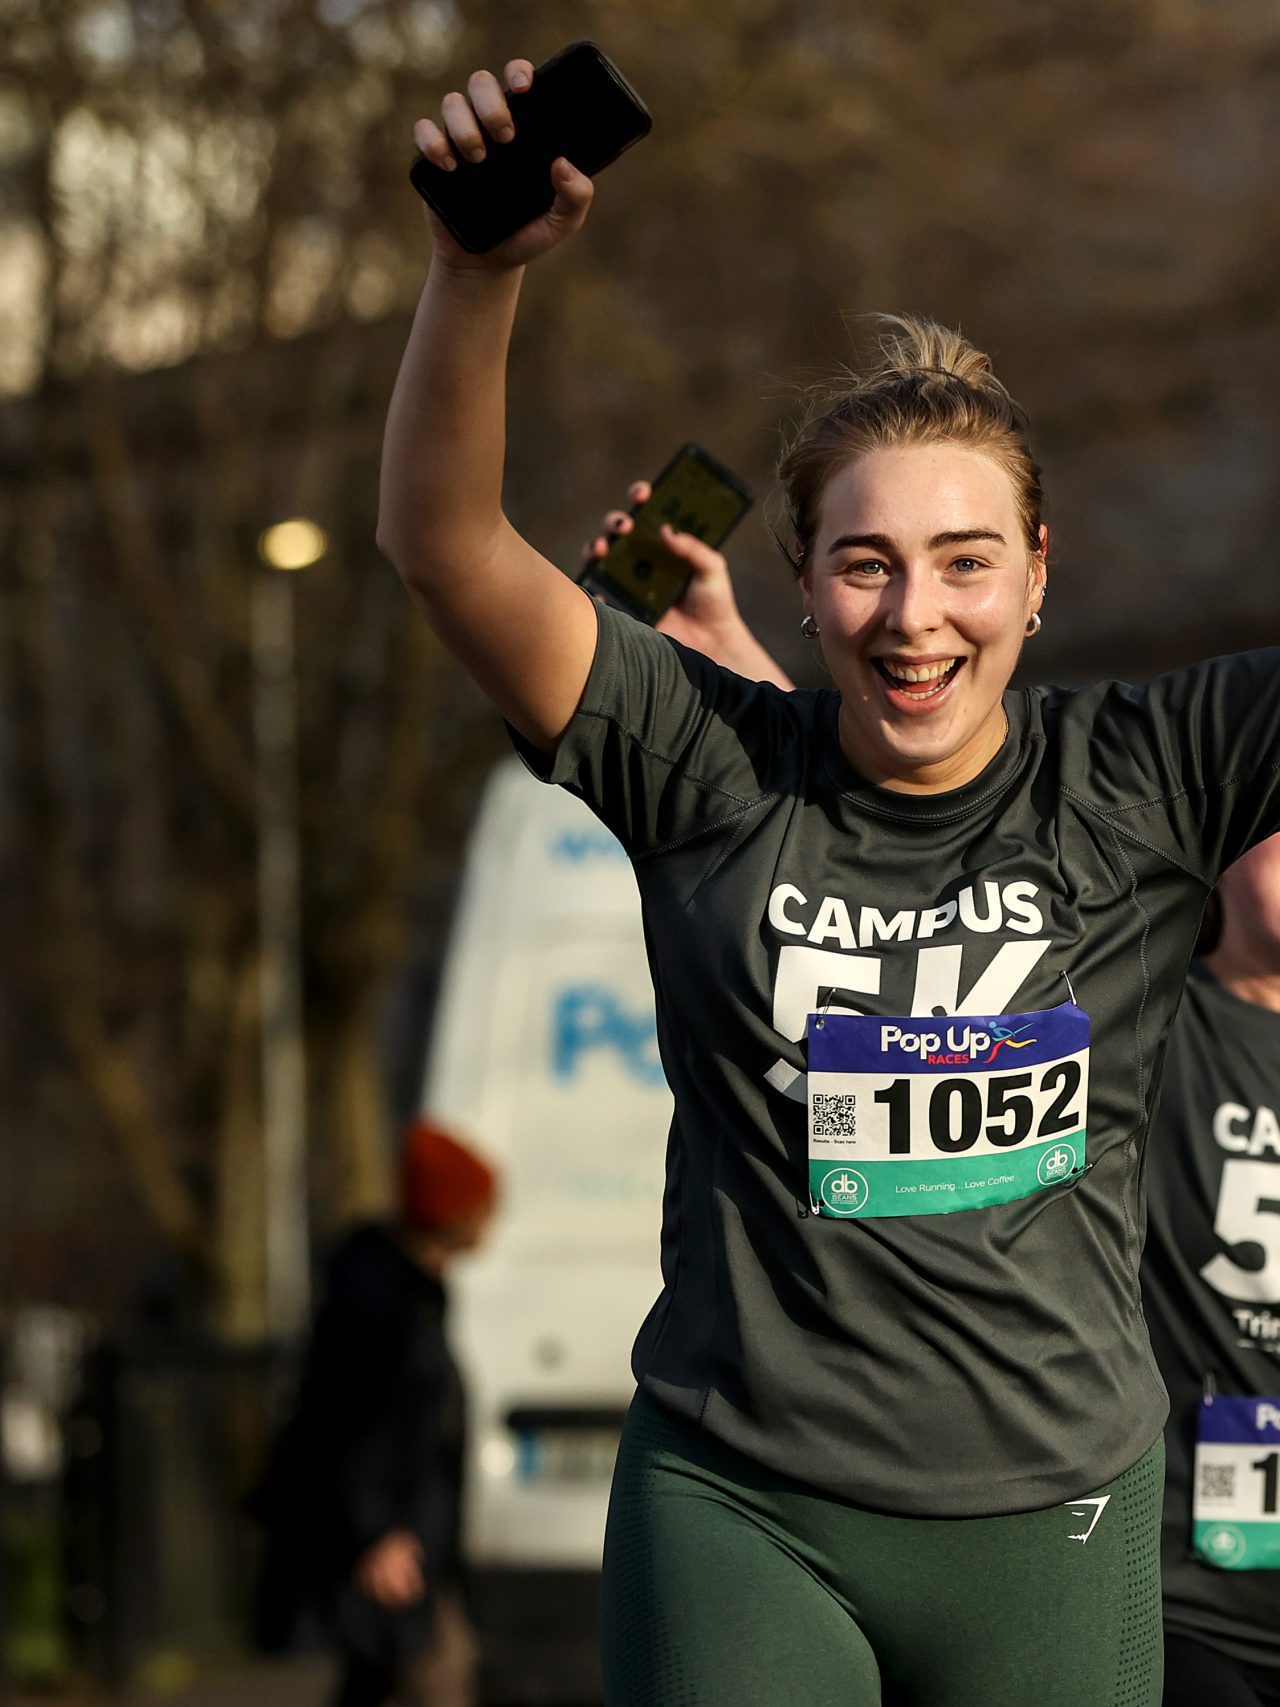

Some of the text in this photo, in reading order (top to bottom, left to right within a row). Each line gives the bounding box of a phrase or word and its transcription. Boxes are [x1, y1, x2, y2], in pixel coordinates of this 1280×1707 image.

[768, 881, 1043, 949] CAMPUS
[881, 1025, 991, 1060] Pop Up
[928, 1054, 970, 1065] RACES
[874, 1060, 1082, 1154] 1052
[895, 1185, 917, 1193] Love
[965, 1180, 985, 1189] Love
[987, 1175, 1015, 1185] Coffee
